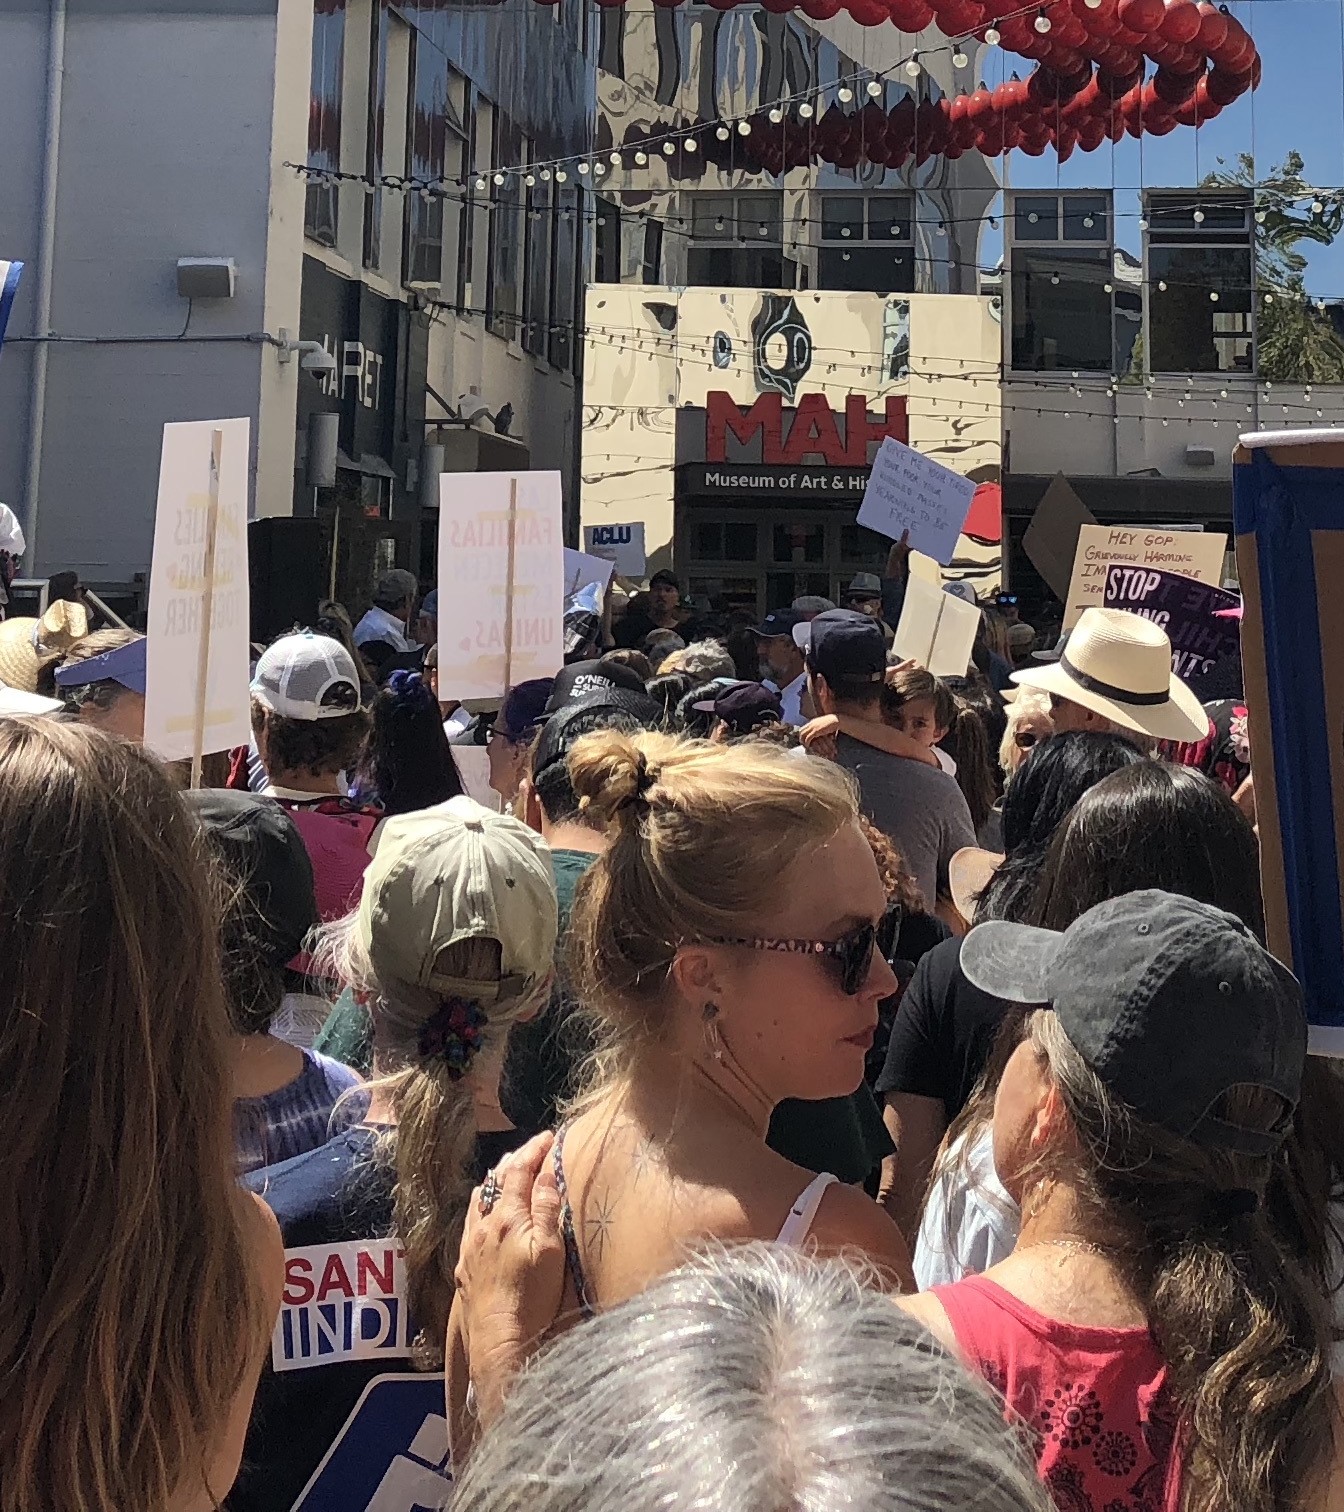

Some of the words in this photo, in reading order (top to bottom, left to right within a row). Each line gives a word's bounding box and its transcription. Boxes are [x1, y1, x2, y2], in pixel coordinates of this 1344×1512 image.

[707, 391, 909, 466] MAH
[706, 473, 774, 488] Museum
[778, 473, 797, 489] of
[800, 475, 827, 489] Art
[831, 476, 844, 490] &
[592, 526, 631, 545] ACLU
[1108, 530, 1137, 546] HEY
[1106, 568, 1161, 601] STOP
